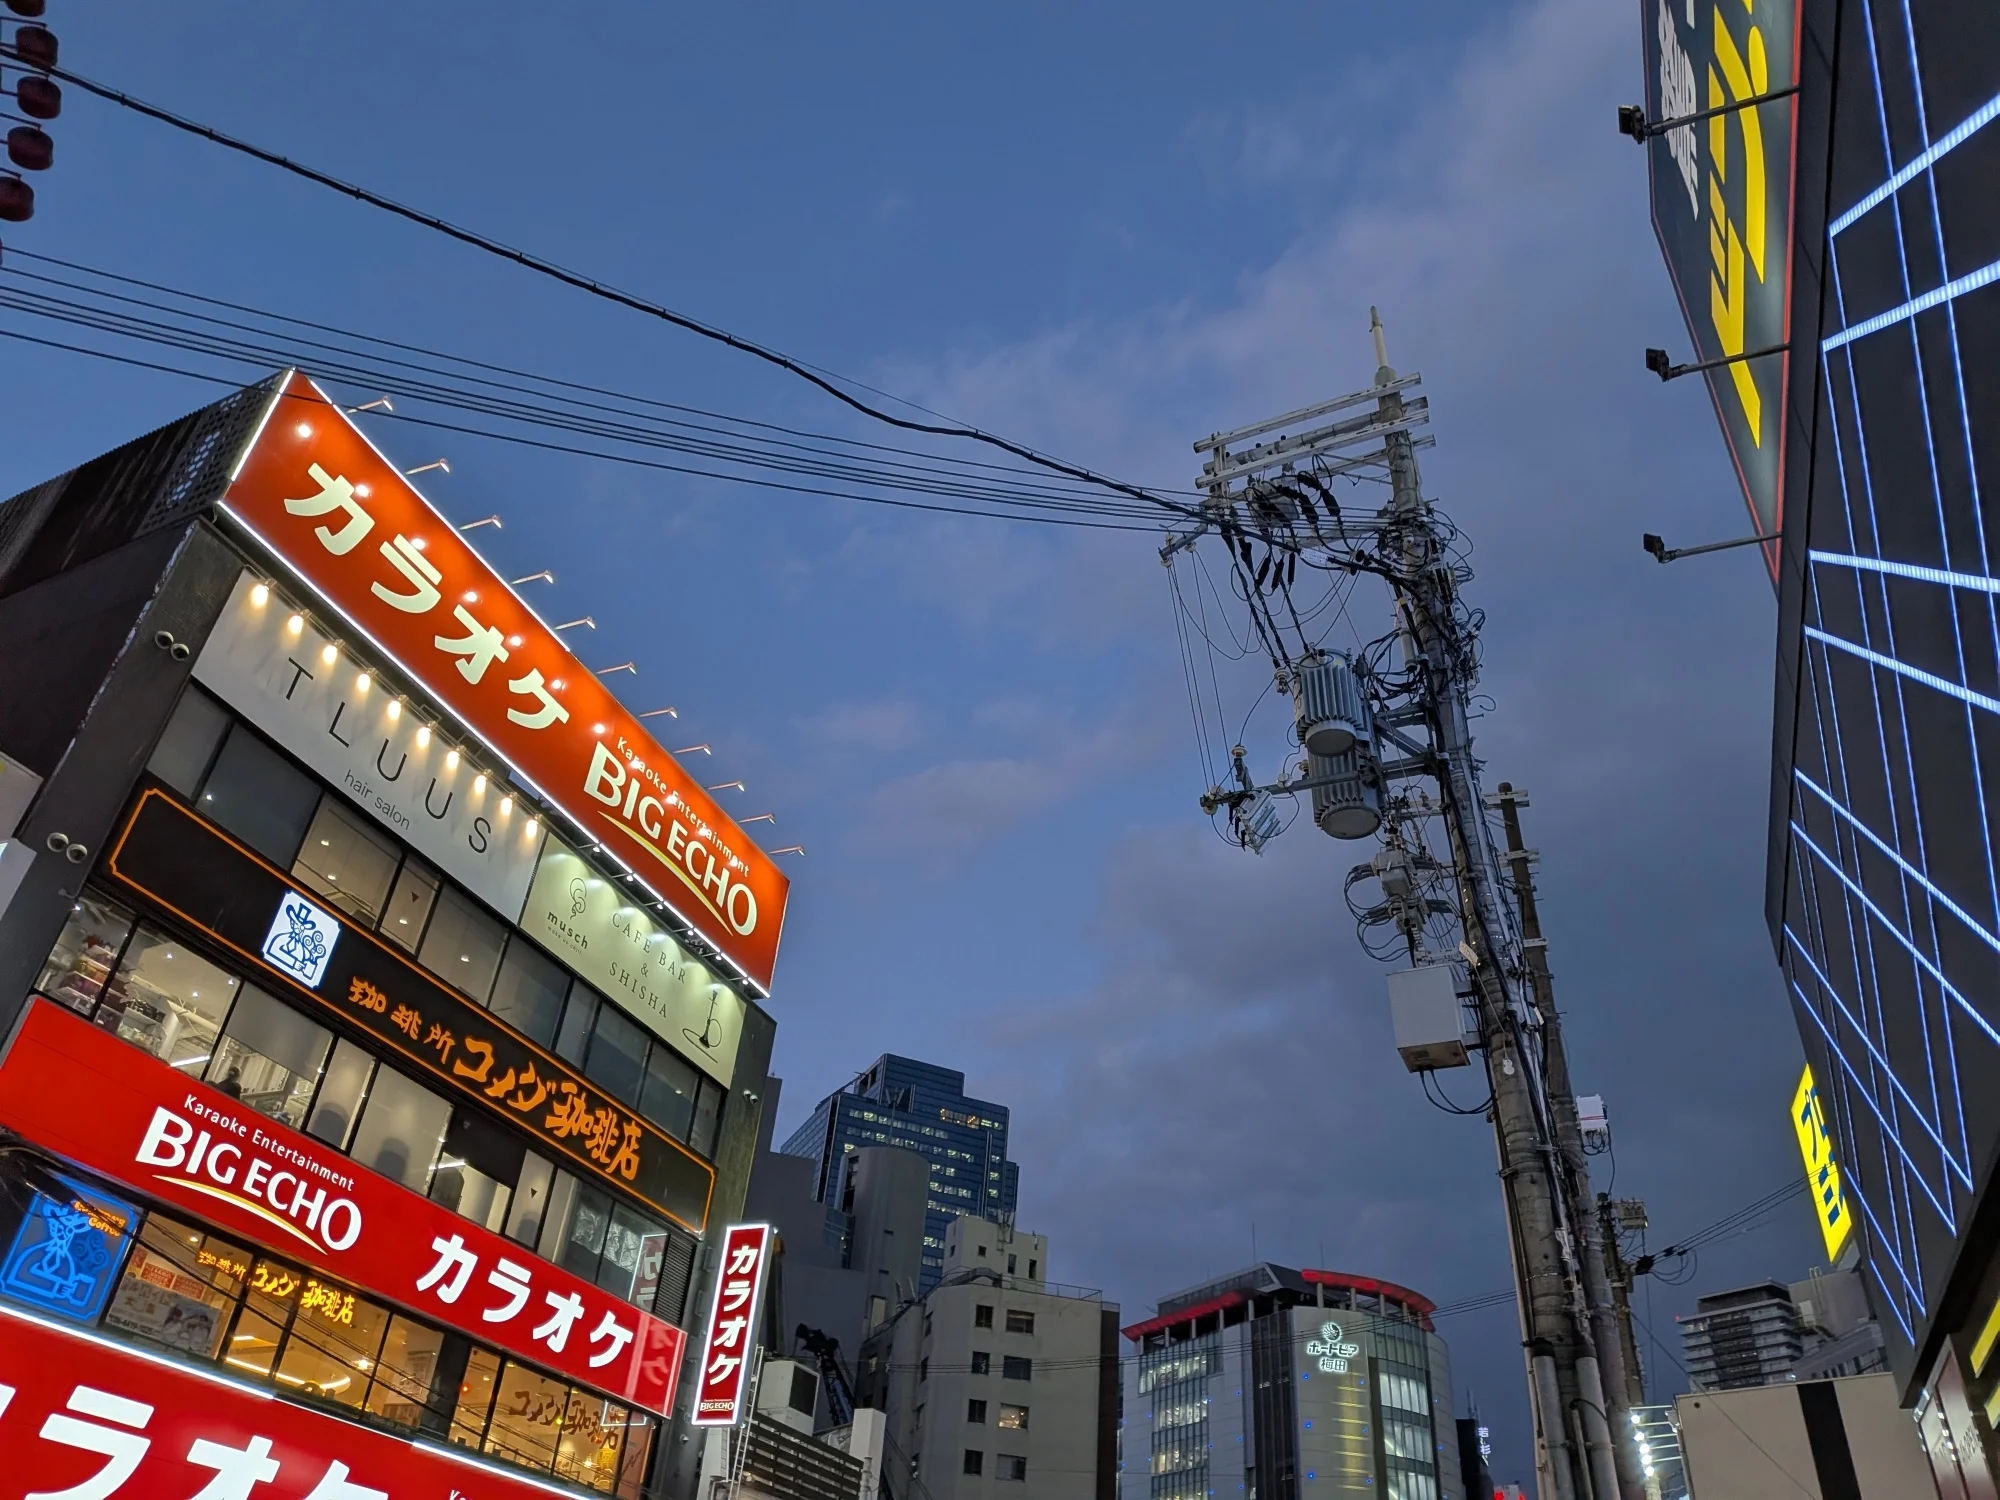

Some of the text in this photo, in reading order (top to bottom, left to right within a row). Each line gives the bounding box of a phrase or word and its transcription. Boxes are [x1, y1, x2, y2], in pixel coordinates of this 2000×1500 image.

[284, 462, 570, 730] カラオケ
[288, 657, 491, 853] TLUUS
[344, 769, 410, 830] hair salon
[617, 736, 750, 877] Karaoke Entertainment
[583, 741, 757, 936] BIG ECHO
[547, 911, 588, 950] musch
[612, 913, 686, 984] CAFE BAR
[641, 963, 648, 977] &
[610, 962, 667, 1018] SHISHA
[184, 1094, 354, 1191] Karaoke Entertainment
[453, 1038, 642, 1181] コメダ珈琲店
[135, 1105, 362, 1251] BIG ECHO
[416, 1234, 633, 1368] カラオケ
[708, 1245, 758, 1385] カラオケ
[700, 1401, 735, 1411] BIG ECHO
[1320, 1358, 1346, 1371] 梅田
